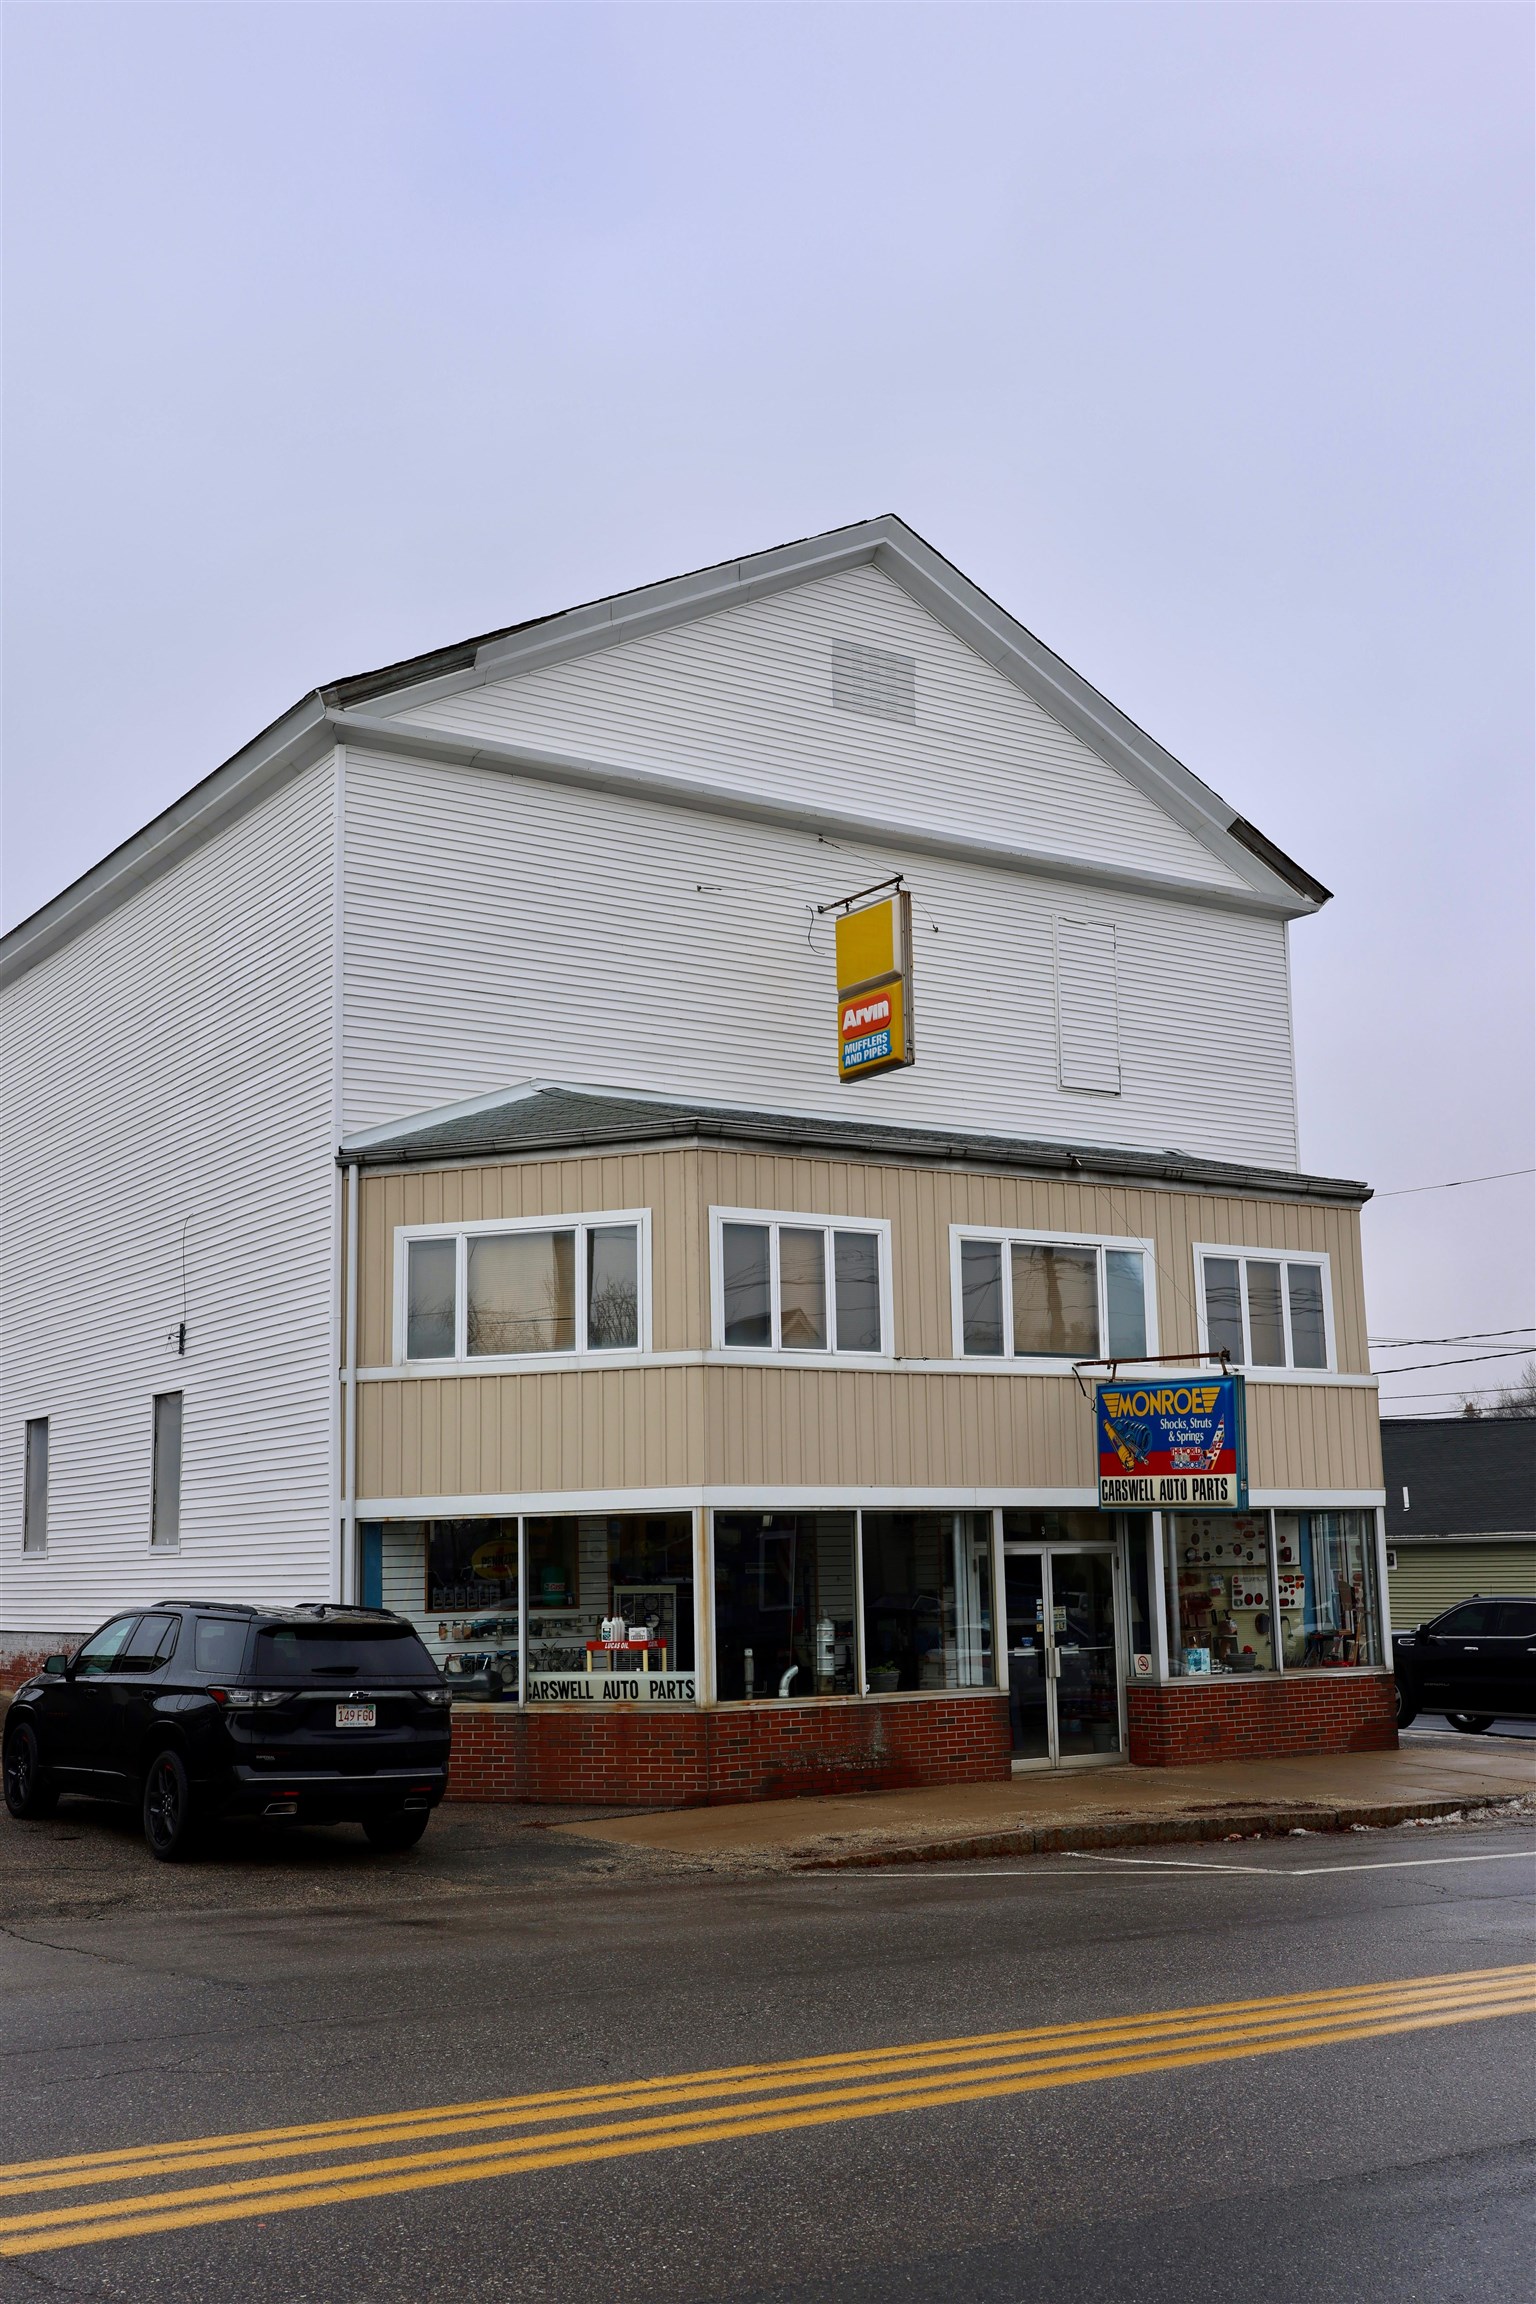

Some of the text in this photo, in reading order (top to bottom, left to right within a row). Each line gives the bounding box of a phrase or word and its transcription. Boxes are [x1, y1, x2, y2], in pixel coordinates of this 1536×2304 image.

[842, 1000, 889, 1031] Arvin
[844, 1032, 888, 1055] MUFFLERS
[845, 1043, 888, 1067] AND PIPES
[1117, 1388, 1205, 1417] MONROE
[1160, 1417, 1212, 1430] Shocks, Struts
[1168, 1430, 1205, 1445] & Springs
[1101, 1477, 1228, 1501] CARSWELL AUTO PARTS
[602, 1680, 639, 1700] AUTO
[649, 1679, 695, 1699] PARTS
[338, 1710, 355, 1721] 149
